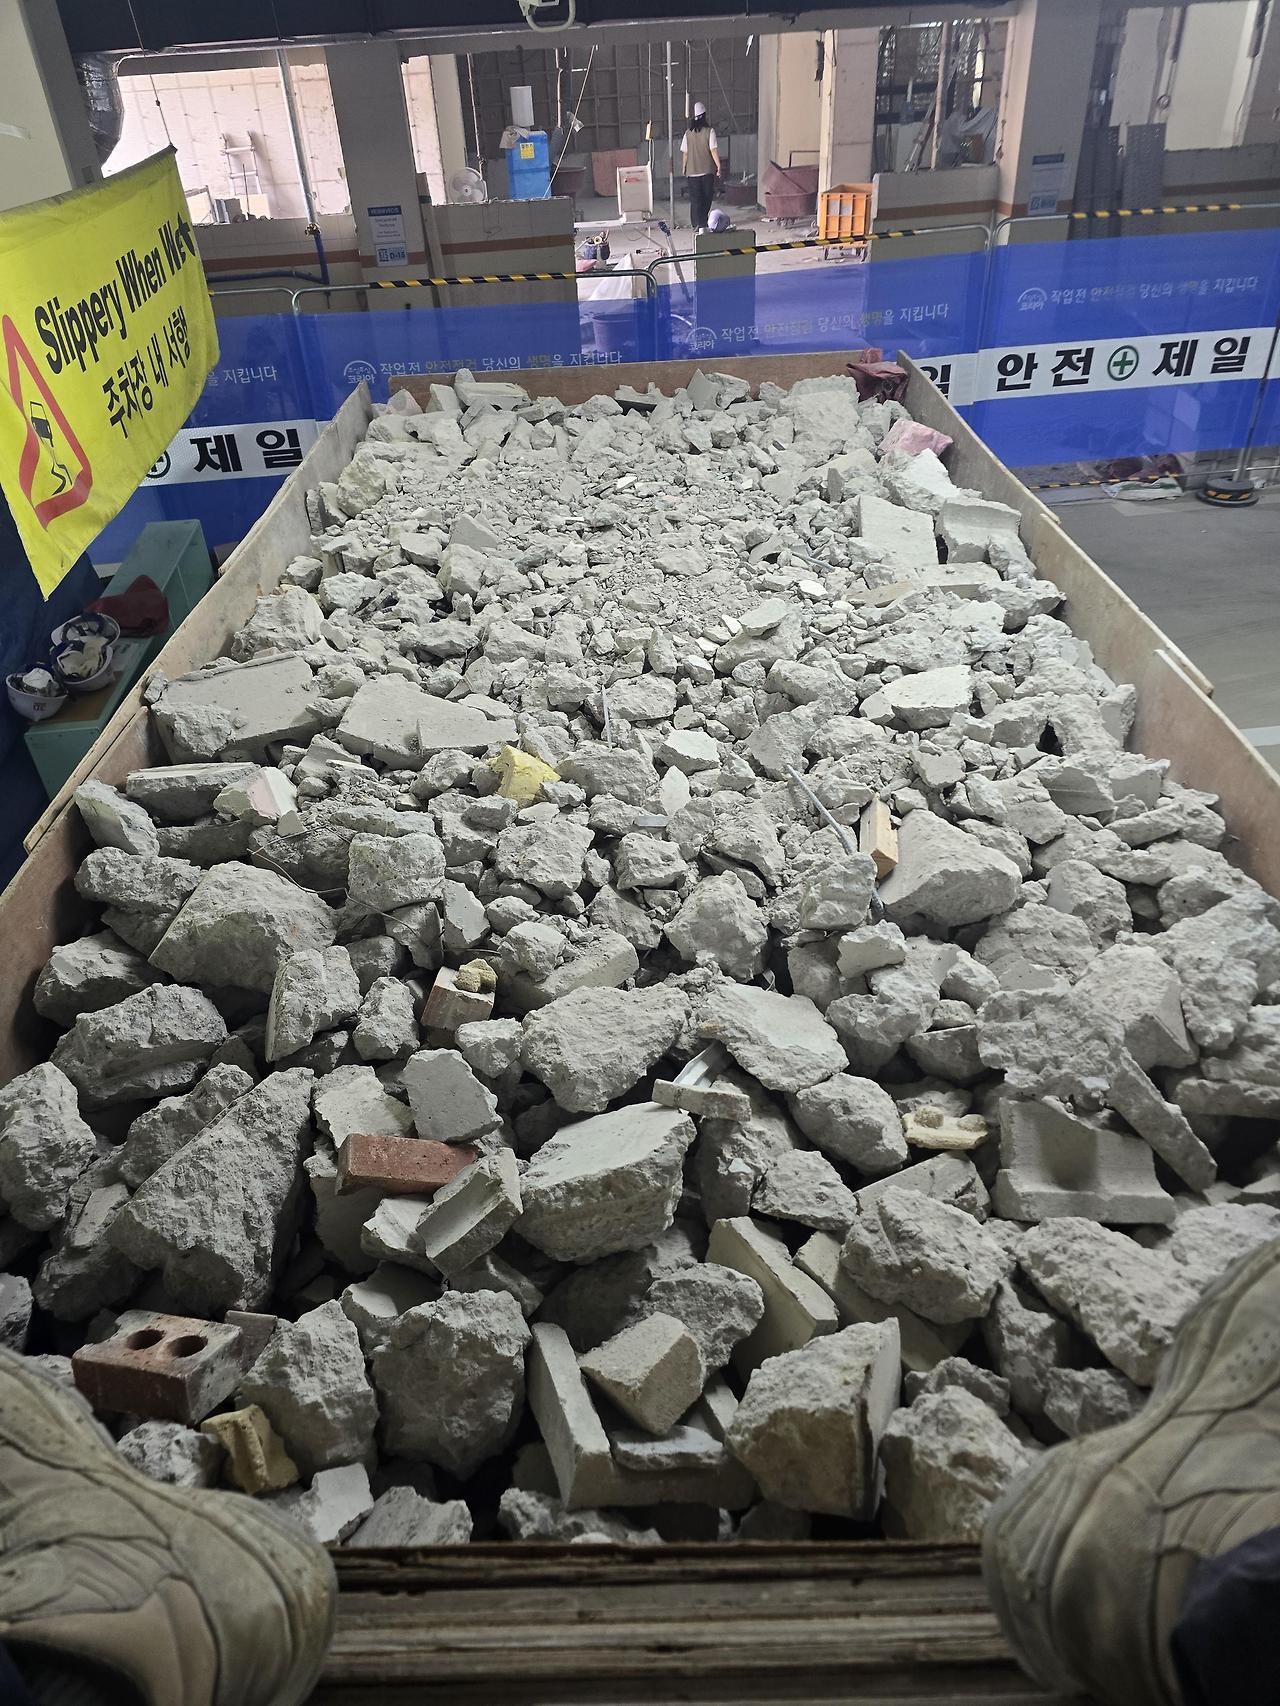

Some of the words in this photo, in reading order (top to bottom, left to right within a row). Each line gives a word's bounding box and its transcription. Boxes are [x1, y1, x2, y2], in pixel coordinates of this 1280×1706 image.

[35, 280, 127, 374] Slippery
[115, 249, 167, 313] When
[721, 326, 759, 342] 작업전
[818, 314, 859, 333] 당신의
[900, 303, 950, 323] 지킵니다
[102, 350, 153, 439] 주차장
[147, 333, 169, 388] 내
[163, 305, 190, 369] 서행
[223, 366, 277, 384] 지킵니다
[482, 356, 521, 371] 당신의
[570, 350, 622, 367] 지킵니다
